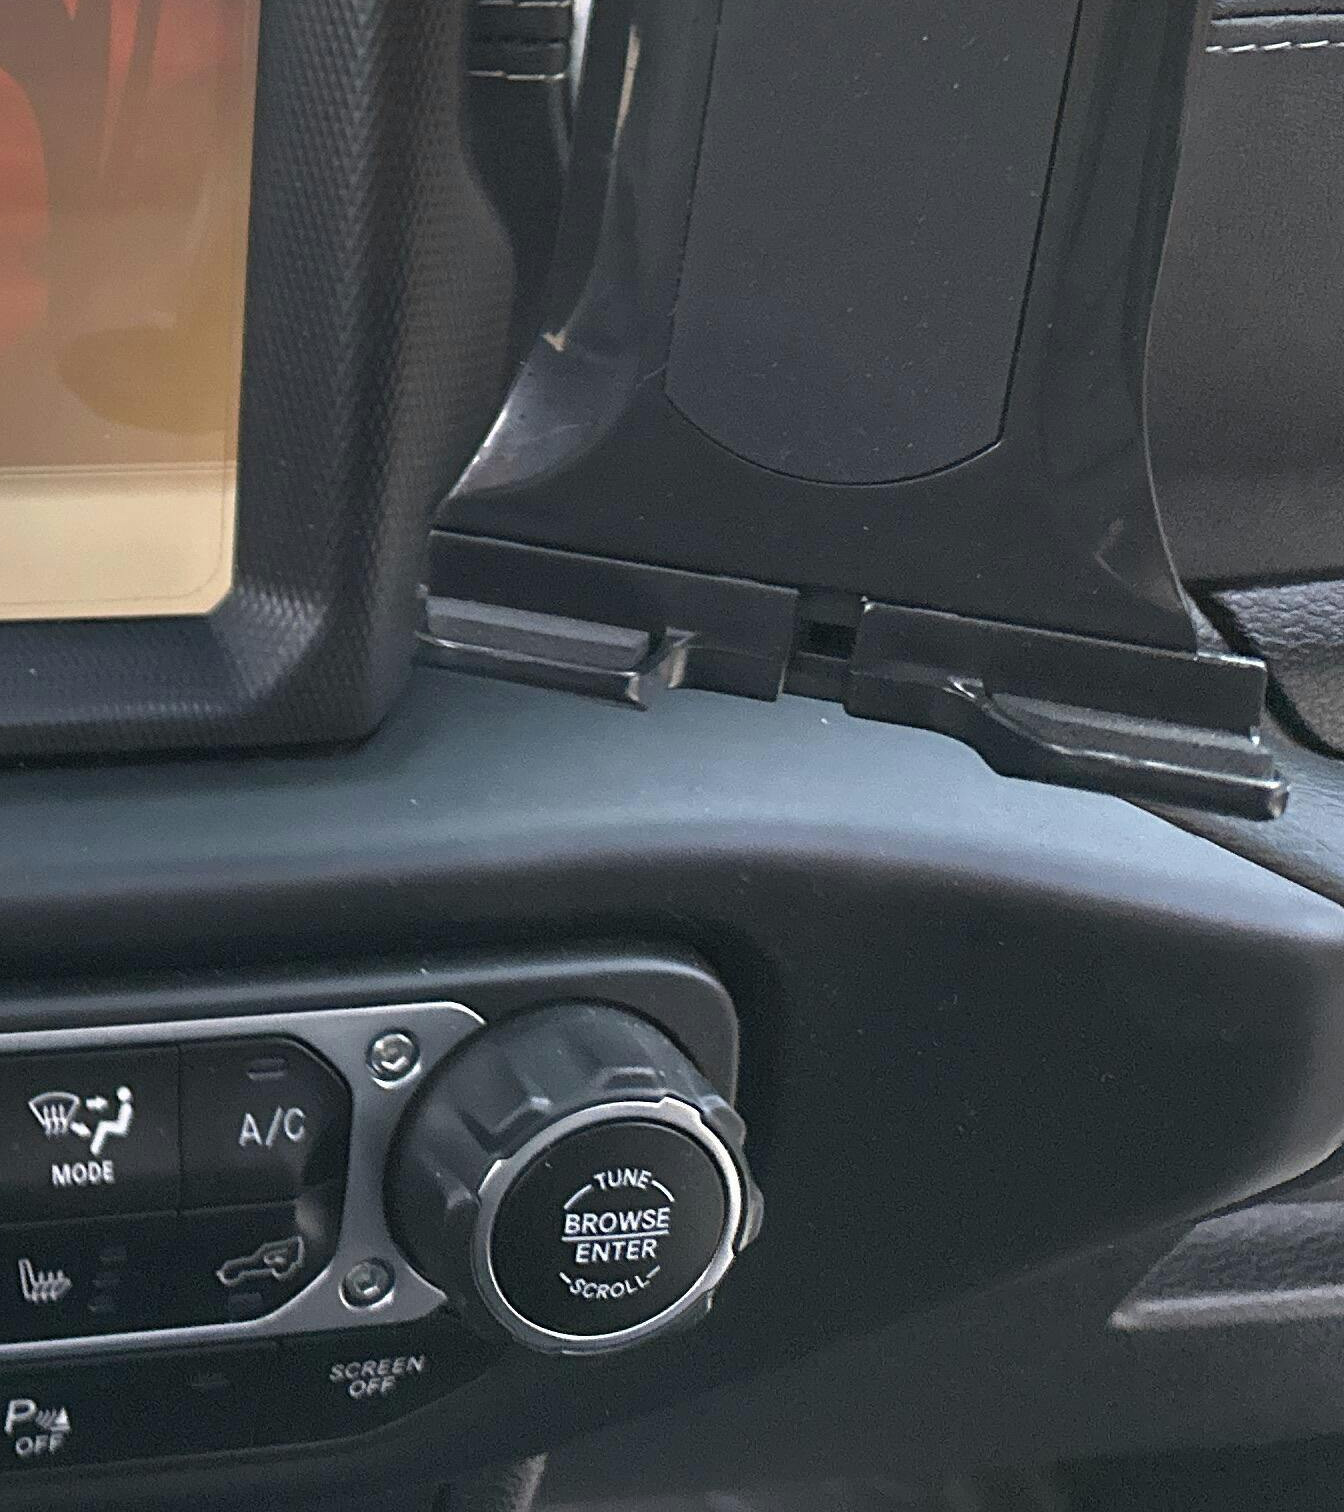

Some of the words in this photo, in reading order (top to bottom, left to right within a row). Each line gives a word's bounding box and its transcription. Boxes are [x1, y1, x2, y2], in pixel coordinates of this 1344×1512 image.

[238, 1105, 307, 1148] A/C
[51, 1159, 115, 1187] MODE
[593, 1168, 654, 1190] TUNE
[564, 1206, 671, 1236] BROWSE
[574, 1239, 657, 1265] ENTER
[568, 1273, 651, 1300] SCROLL
[329, 1354, 426, 1383] SCREEN
[348, 1375, 397, 1400] OFF
[15, 1436, 64, 1459] OFF
